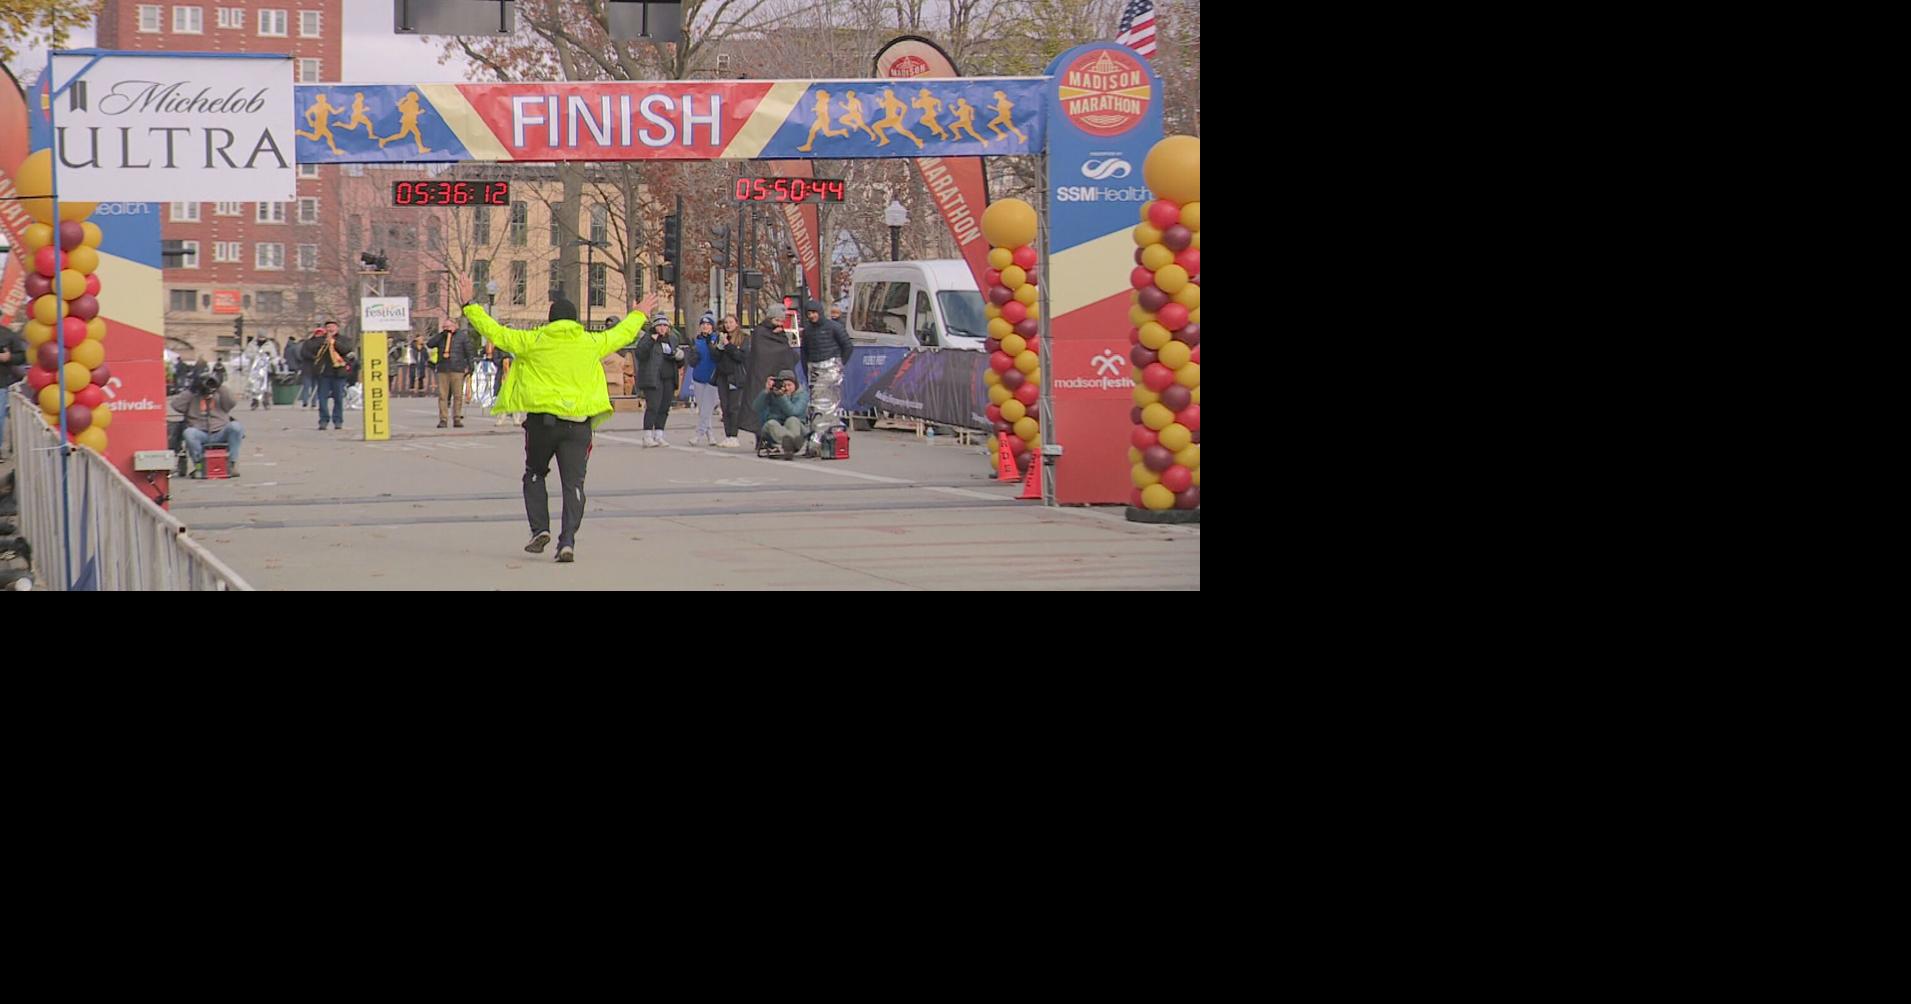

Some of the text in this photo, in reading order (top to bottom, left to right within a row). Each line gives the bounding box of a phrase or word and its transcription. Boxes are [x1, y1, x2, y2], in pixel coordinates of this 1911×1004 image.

[99, 80, 269, 116] Michelob
[1069, 71, 1140, 91] MADISON
[513, 94, 722, 148] FINISH
[1070, 95, 1140, 116] MARATHON
[55, 126, 290, 169] ULTRA
[396, 182, 508, 204] 05:36:12
[736, 178, 844, 202] 05:50:44
[916, 157, 981, 246] MARATHON
[783, 203, 817, 272] MARATHON
[371, 387, 384, 435] BELL
